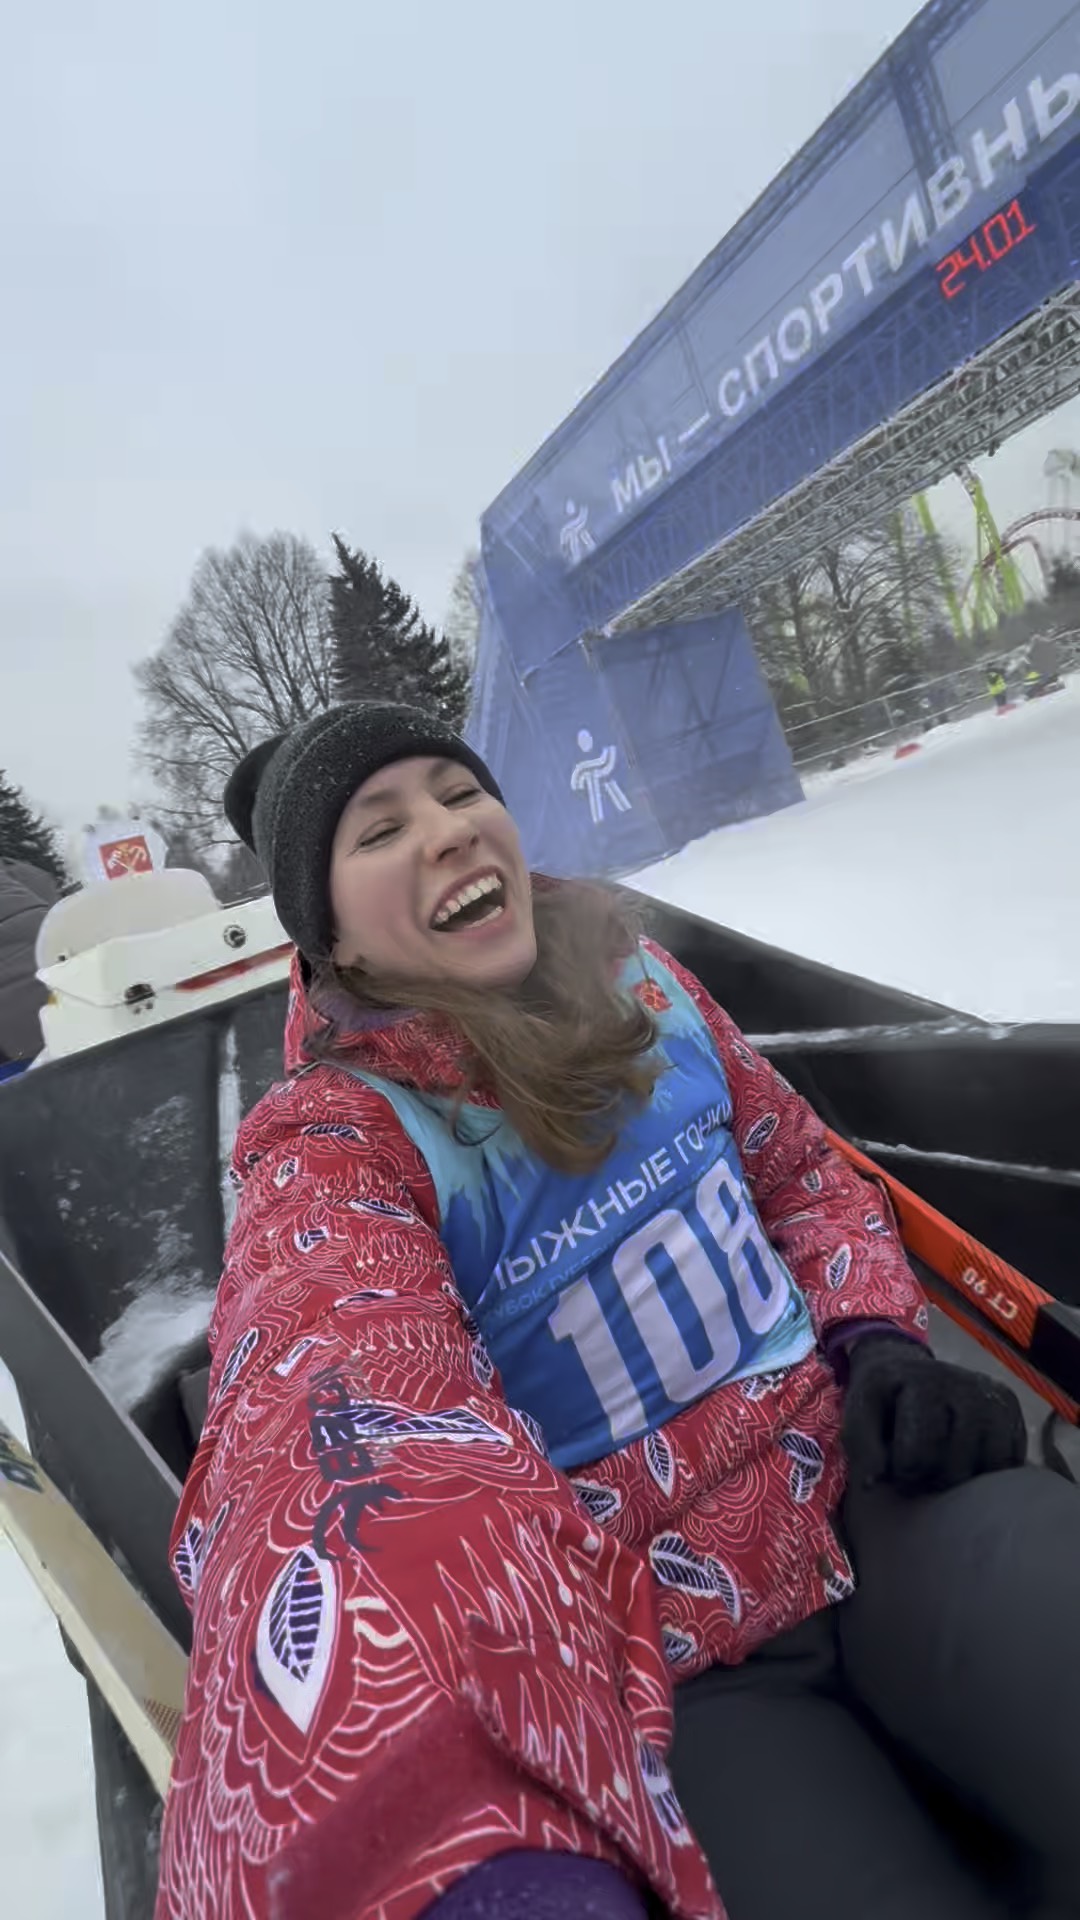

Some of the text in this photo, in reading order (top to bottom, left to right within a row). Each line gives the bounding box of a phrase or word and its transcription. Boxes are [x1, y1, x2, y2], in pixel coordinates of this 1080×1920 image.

[936, 199, 1036, 299] 24.01
[611, 435, 671, 513] МЫ
[548, 1157, 790, 1441] 108
